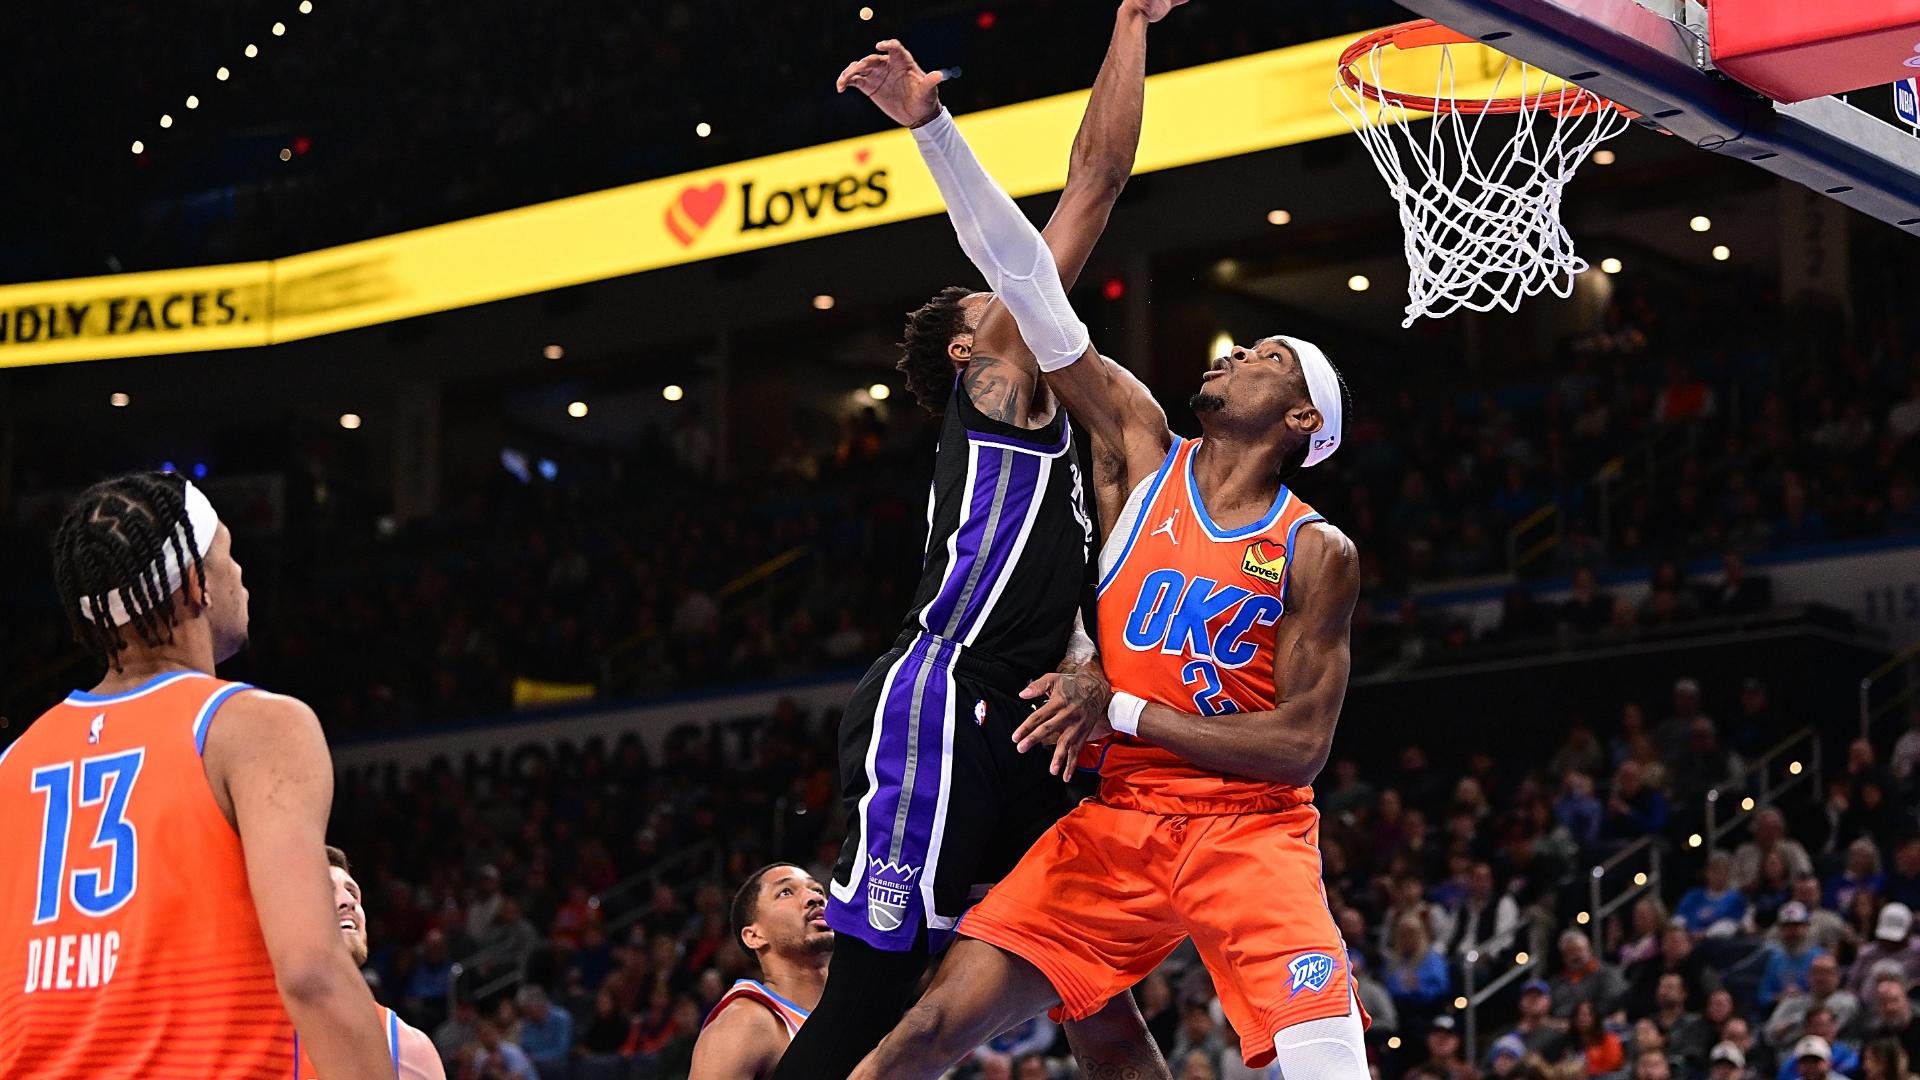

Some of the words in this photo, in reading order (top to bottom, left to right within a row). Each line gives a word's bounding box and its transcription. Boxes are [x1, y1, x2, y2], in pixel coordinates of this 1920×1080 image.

[1898, 88, 1915, 116] NBA
[107, 288, 250, 335] FACES.
[1123, 568, 1284, 670] OKC
[1181, 659, 1239, 717] 2
[31, 746, 146, 926] 13
[868, 884, 910, 907] KINGS
[24, 931, 121, 994] DIENG
[1292, 958, 1325, 991] OKC
